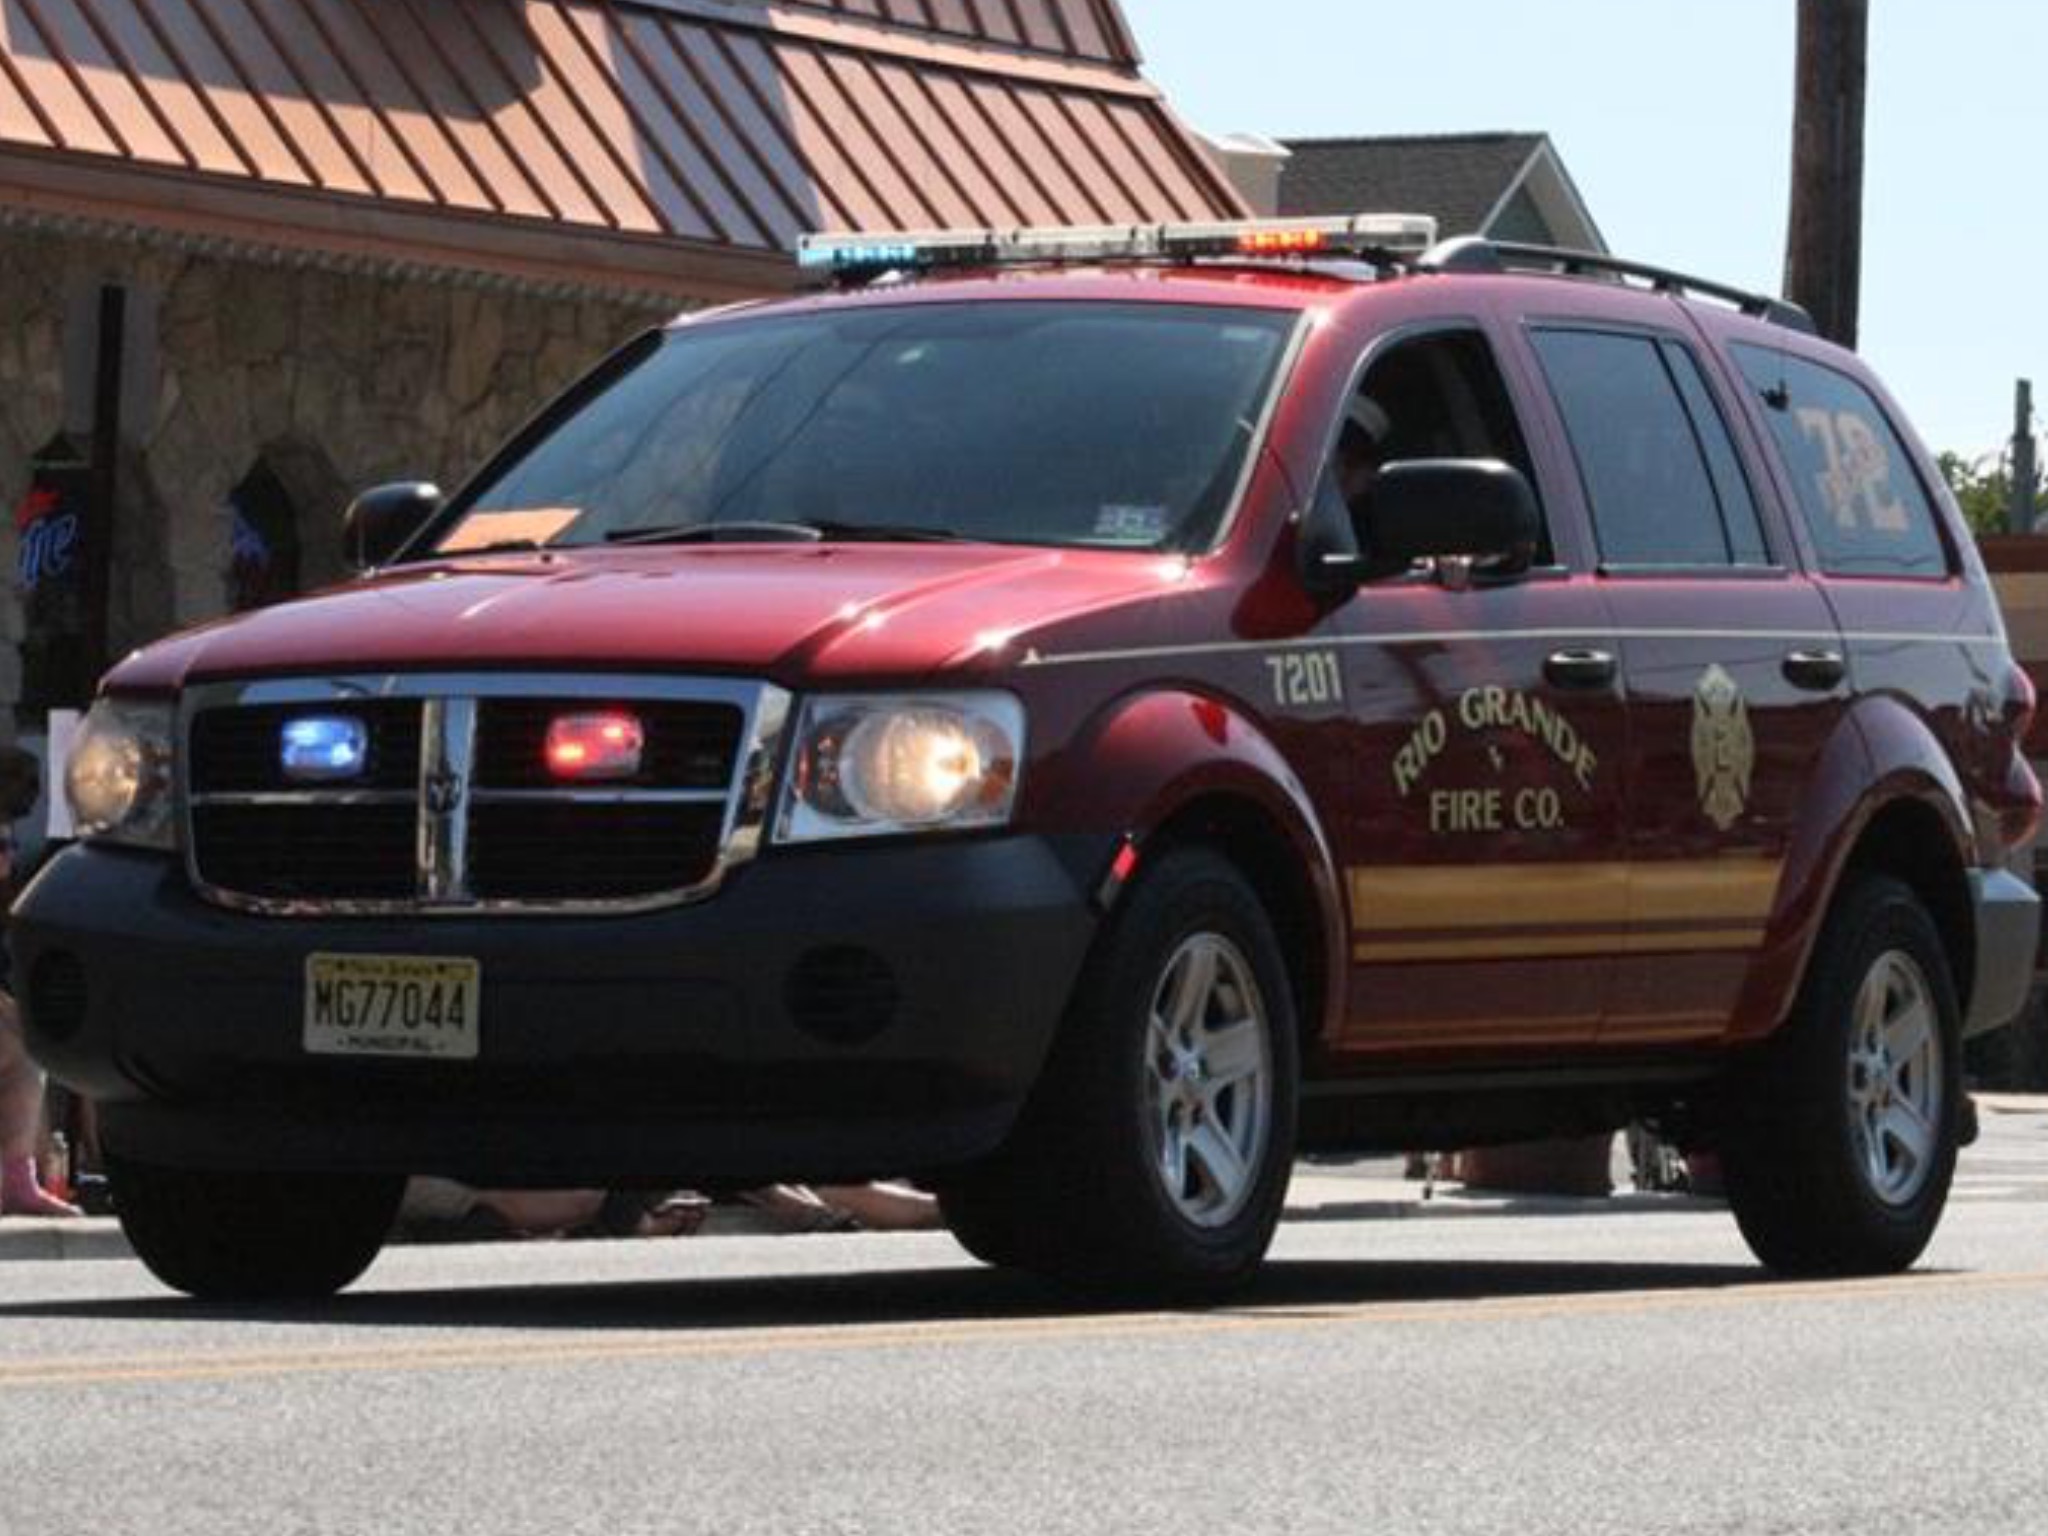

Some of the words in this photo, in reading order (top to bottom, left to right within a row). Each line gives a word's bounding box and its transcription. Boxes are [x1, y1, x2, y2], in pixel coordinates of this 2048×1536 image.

[1264, 653, 1342, 704] 7201
[1392, 708, 1447, 796] RIO
[1459, 684, 1598, 792] GRANDE
[1430, 790, 1501, 832] FIRE
[1514, 787, 1565, 828] CO.
[313, 978, 466, 1031] MG77044
